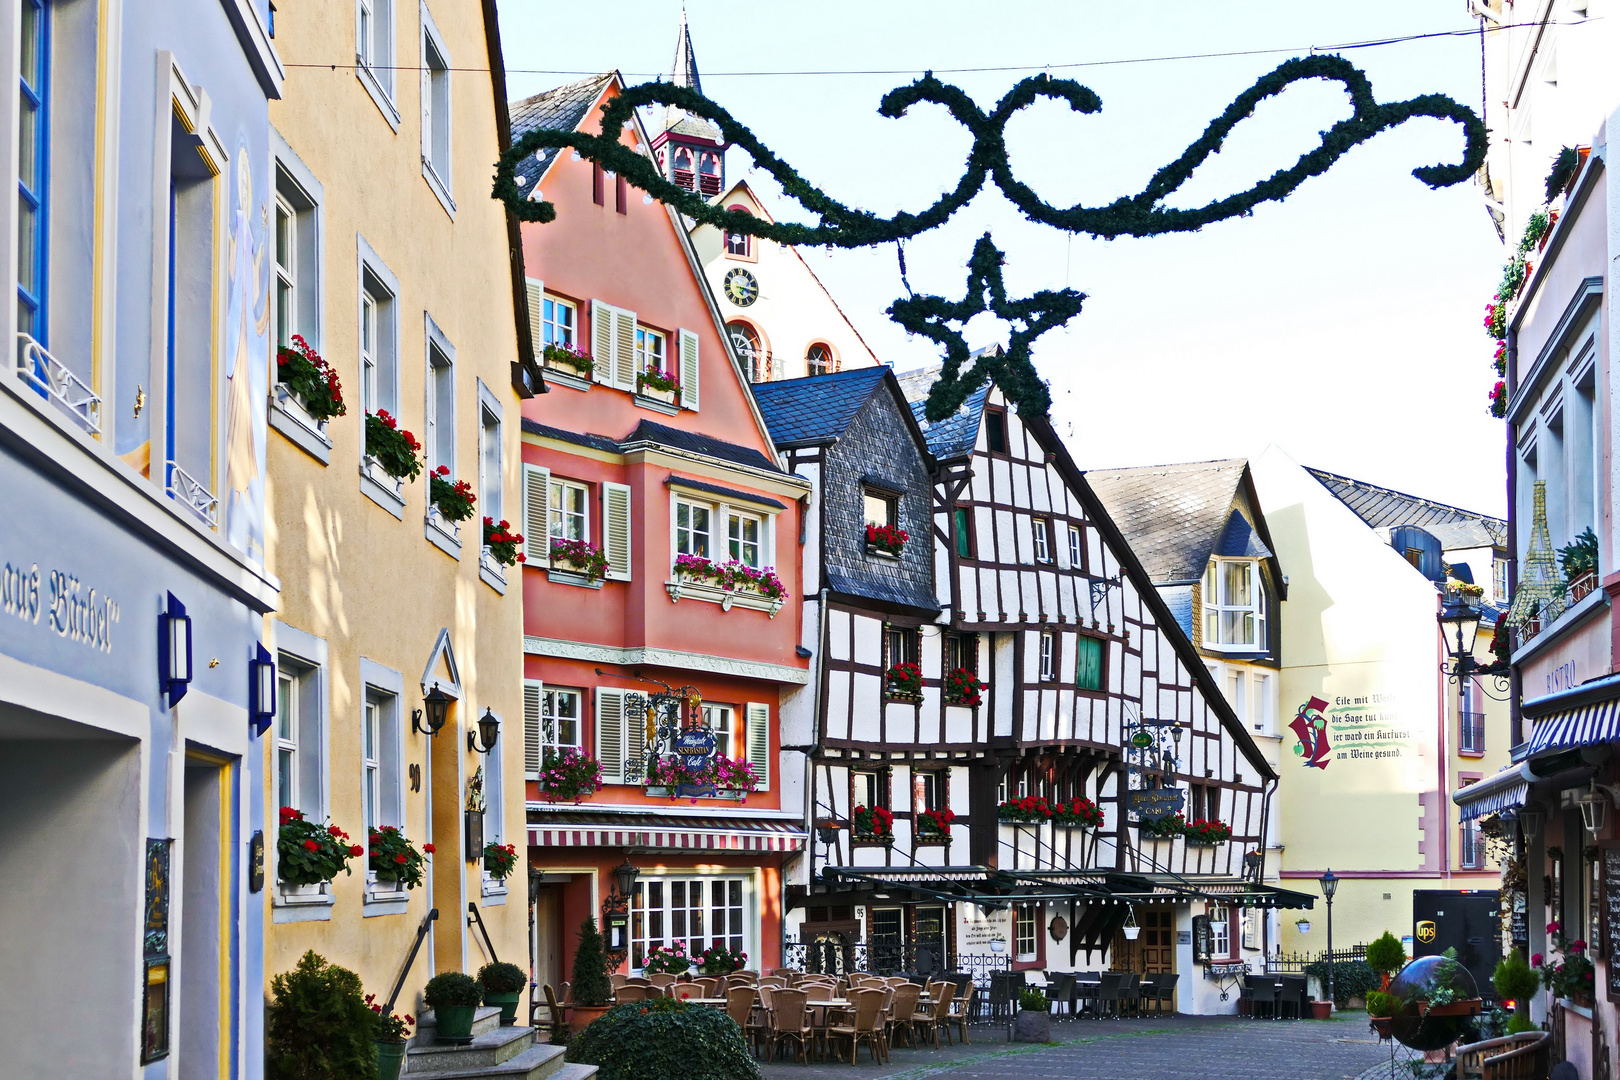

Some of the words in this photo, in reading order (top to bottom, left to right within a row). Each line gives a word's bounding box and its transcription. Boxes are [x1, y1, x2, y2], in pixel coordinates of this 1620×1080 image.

[0, 561, 41, 626] aus
[1546, 659, 1576, 694] BISTRO
[1335, 696, 1351, 706] Eile
[1354, 695, 1369, 705] mit
[1331, 714, 1342, 724] die
[1344, 713, 1363, 724] Sage
[1365, 714, 1377, 722] tut
[1344, 732, 1362, 741] ward
[1364, 731, 1375, 741] ein
[1336, 751, 1348, 760] am
[1350, 749, 1374, 759] Weine
[857, 908, 864, 918] 95
